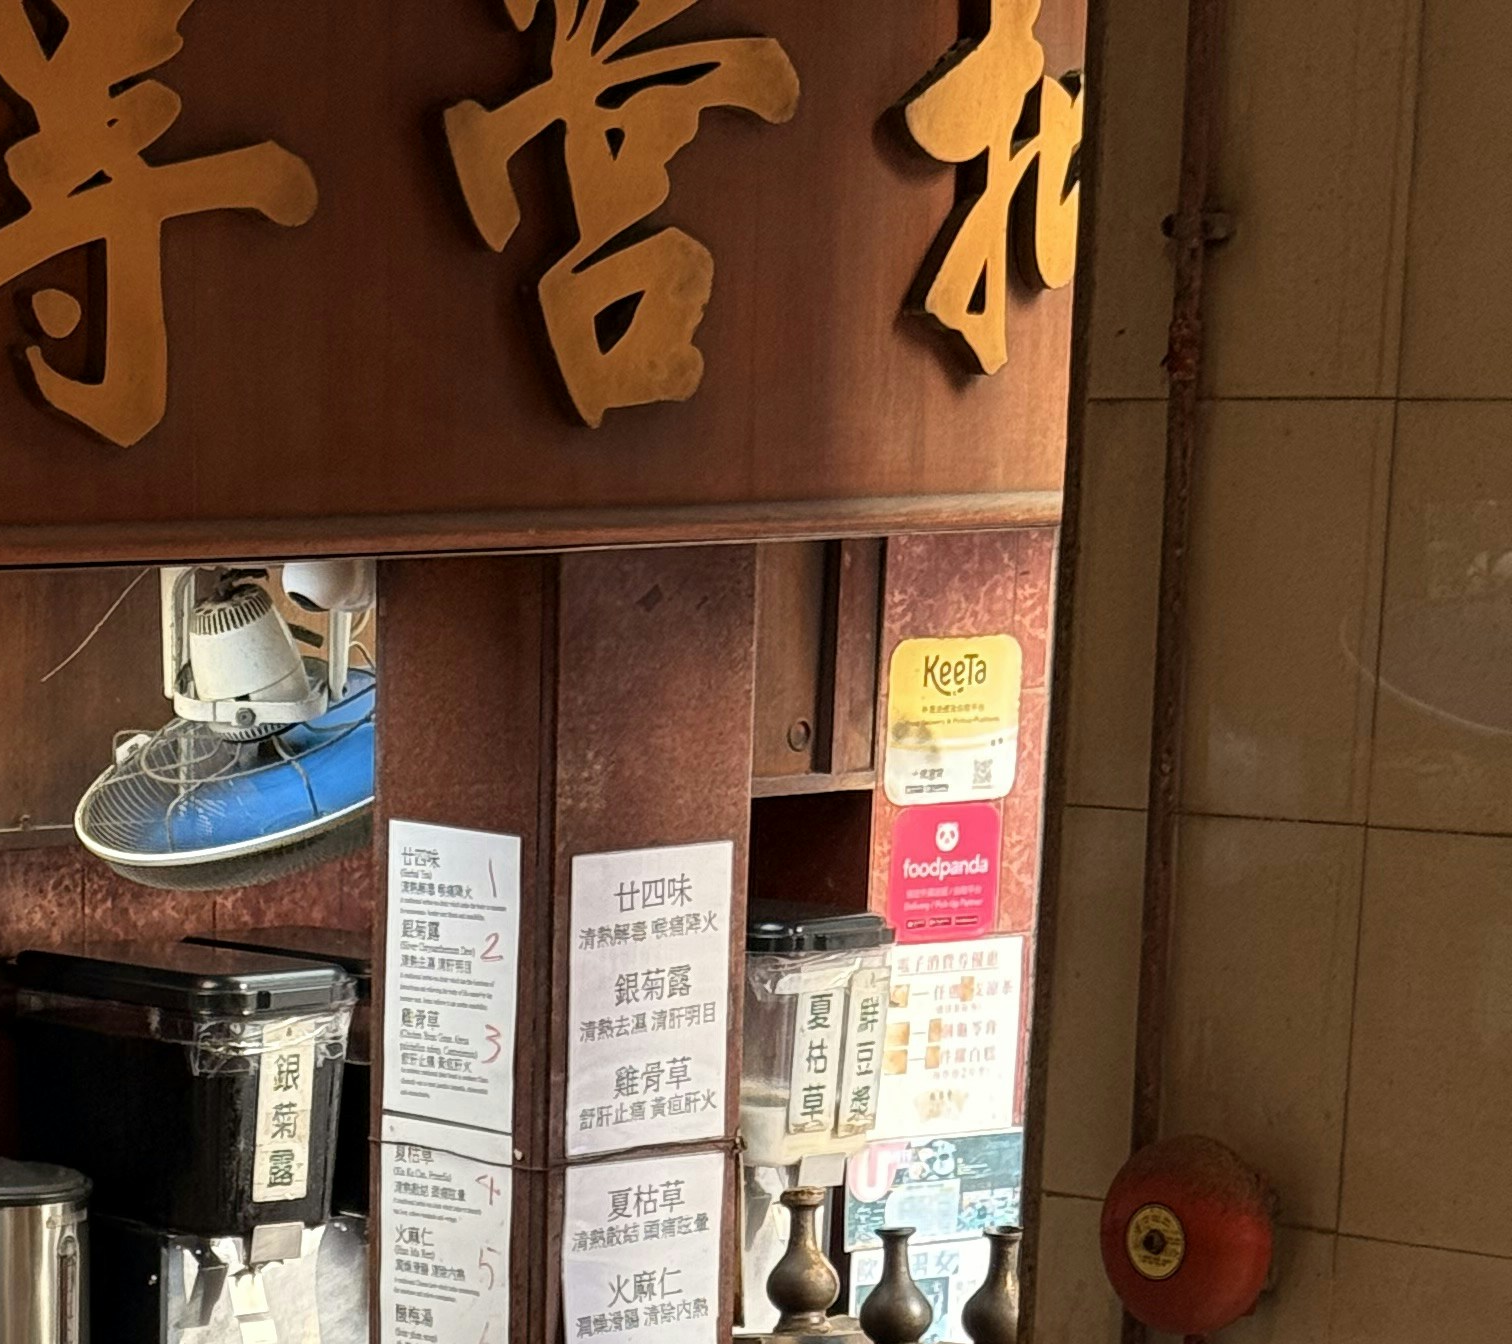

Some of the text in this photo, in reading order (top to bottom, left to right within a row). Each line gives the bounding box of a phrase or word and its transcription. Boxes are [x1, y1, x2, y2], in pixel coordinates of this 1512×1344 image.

[903, 853, 989, 881] foodpanda
[614, 873, 692, 913] 廿四味
[479, 932, 504, 960] 2
[614, 964, 692, 1007] 銀菊露
[481, 1024, 502, 1064] 3
[800, 993, 833, 1121] 夏枯草
[613, 1056, 692, 1099] 雞骨草
[266, 1053, 300, 1188] 銀菊露
[475, 1174, 501, 1206] 4
[608, 1179, 685, 1222] 夏枯草
[479, 1246, 502, 1291] 5
[608, 1267, 683, 1308] 火麻仁
